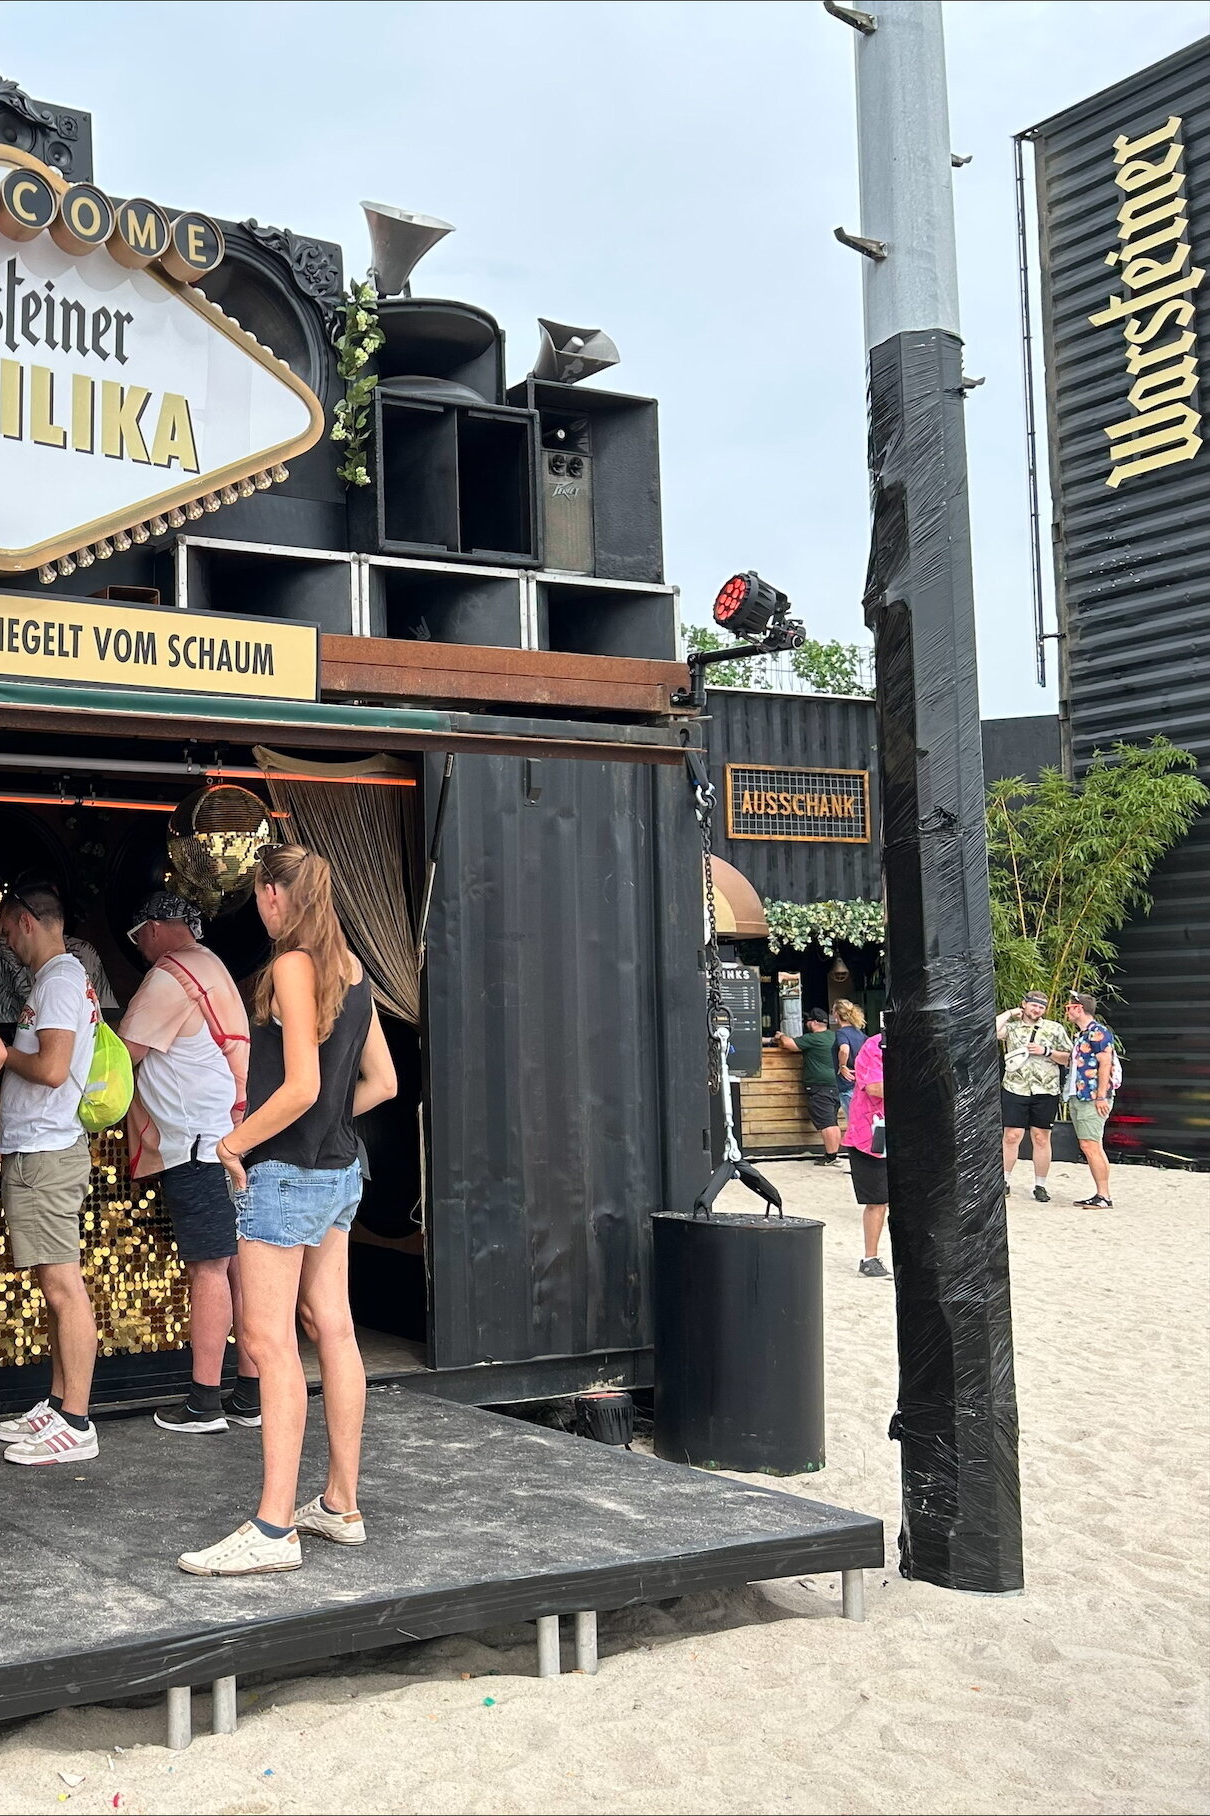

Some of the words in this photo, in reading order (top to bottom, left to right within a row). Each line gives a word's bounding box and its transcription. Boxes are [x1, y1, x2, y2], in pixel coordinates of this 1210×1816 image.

[1087, 116, 1207, 489] Warsteiner
[93, 626, 157, 666] VOM
[168, 633, 275, 676] SCHAUM
[742, 790, 855, 818] AUSSCHANK
